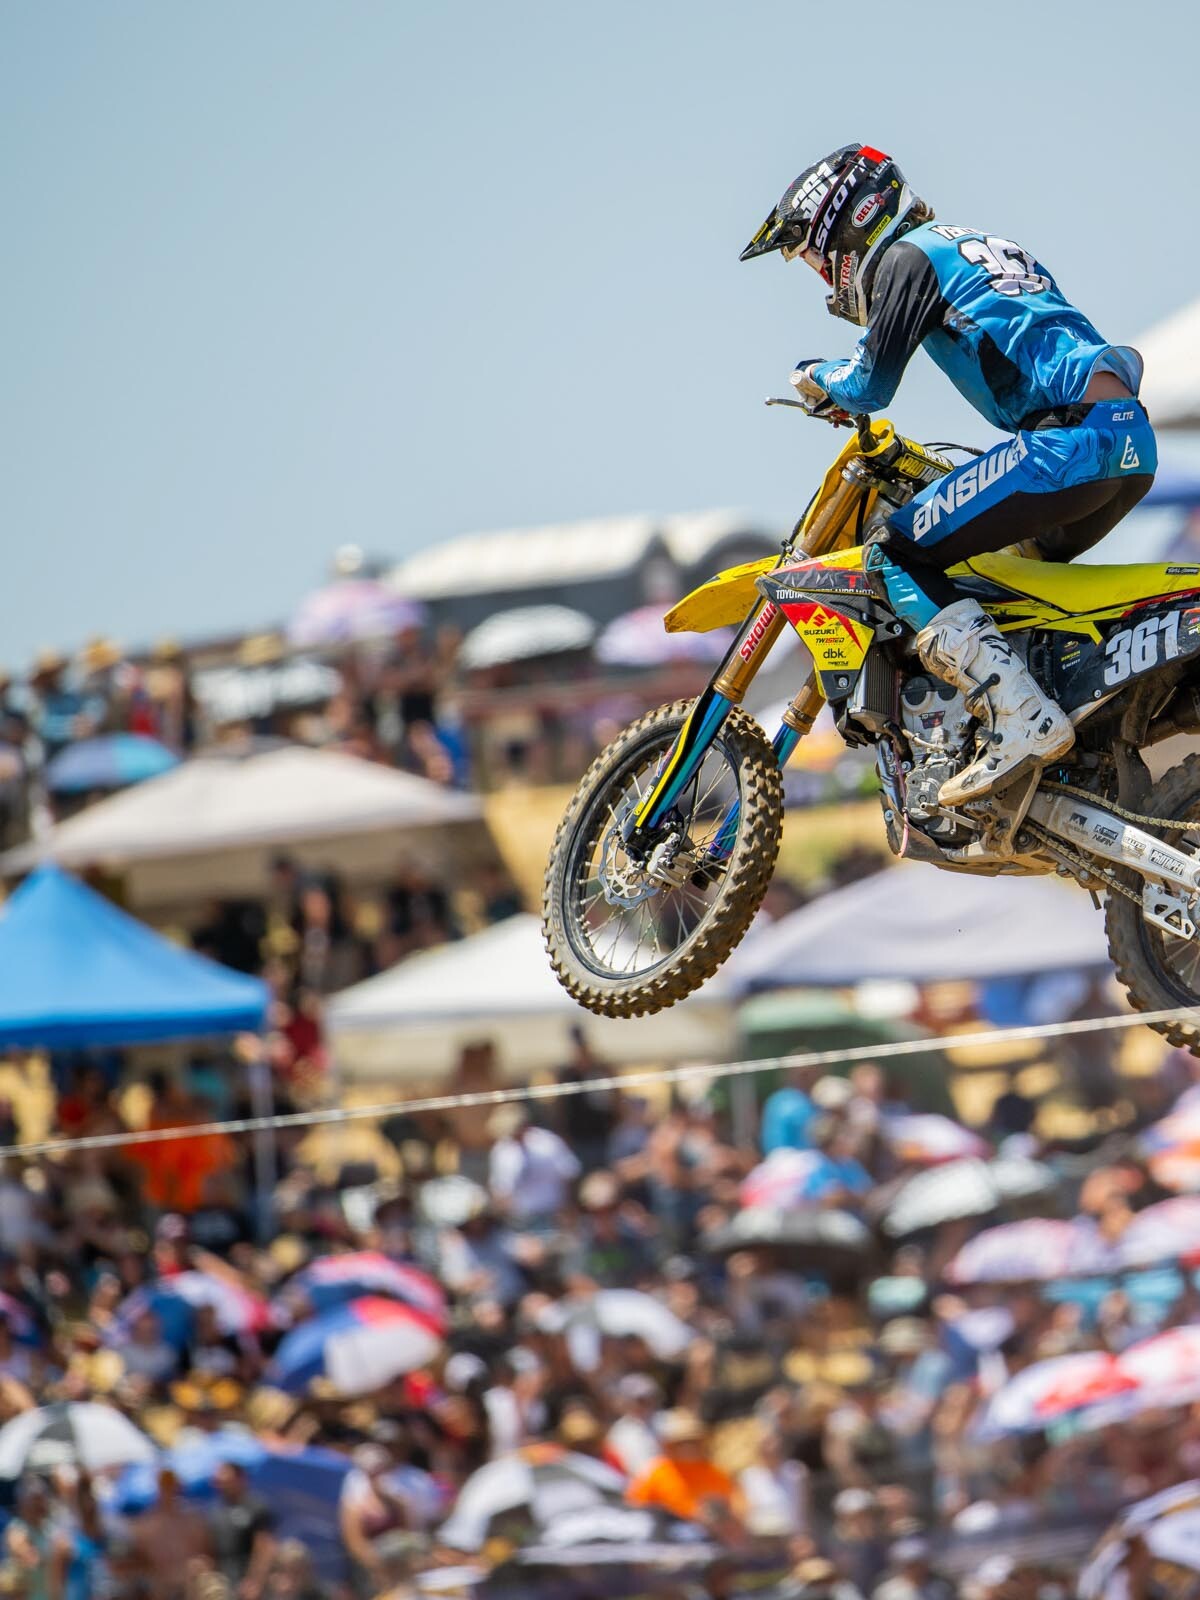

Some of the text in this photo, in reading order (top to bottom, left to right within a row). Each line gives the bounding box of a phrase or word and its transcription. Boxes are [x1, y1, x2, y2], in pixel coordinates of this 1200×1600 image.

[856, 199, 877, 223] BELL
[1112, 411, 1135, 421] ELITE
[776, 589, 803, 600] TOYOTA
[1104, 610, 1180, 686] 361
[1152, 849, 1184, 876] PROTAPER
